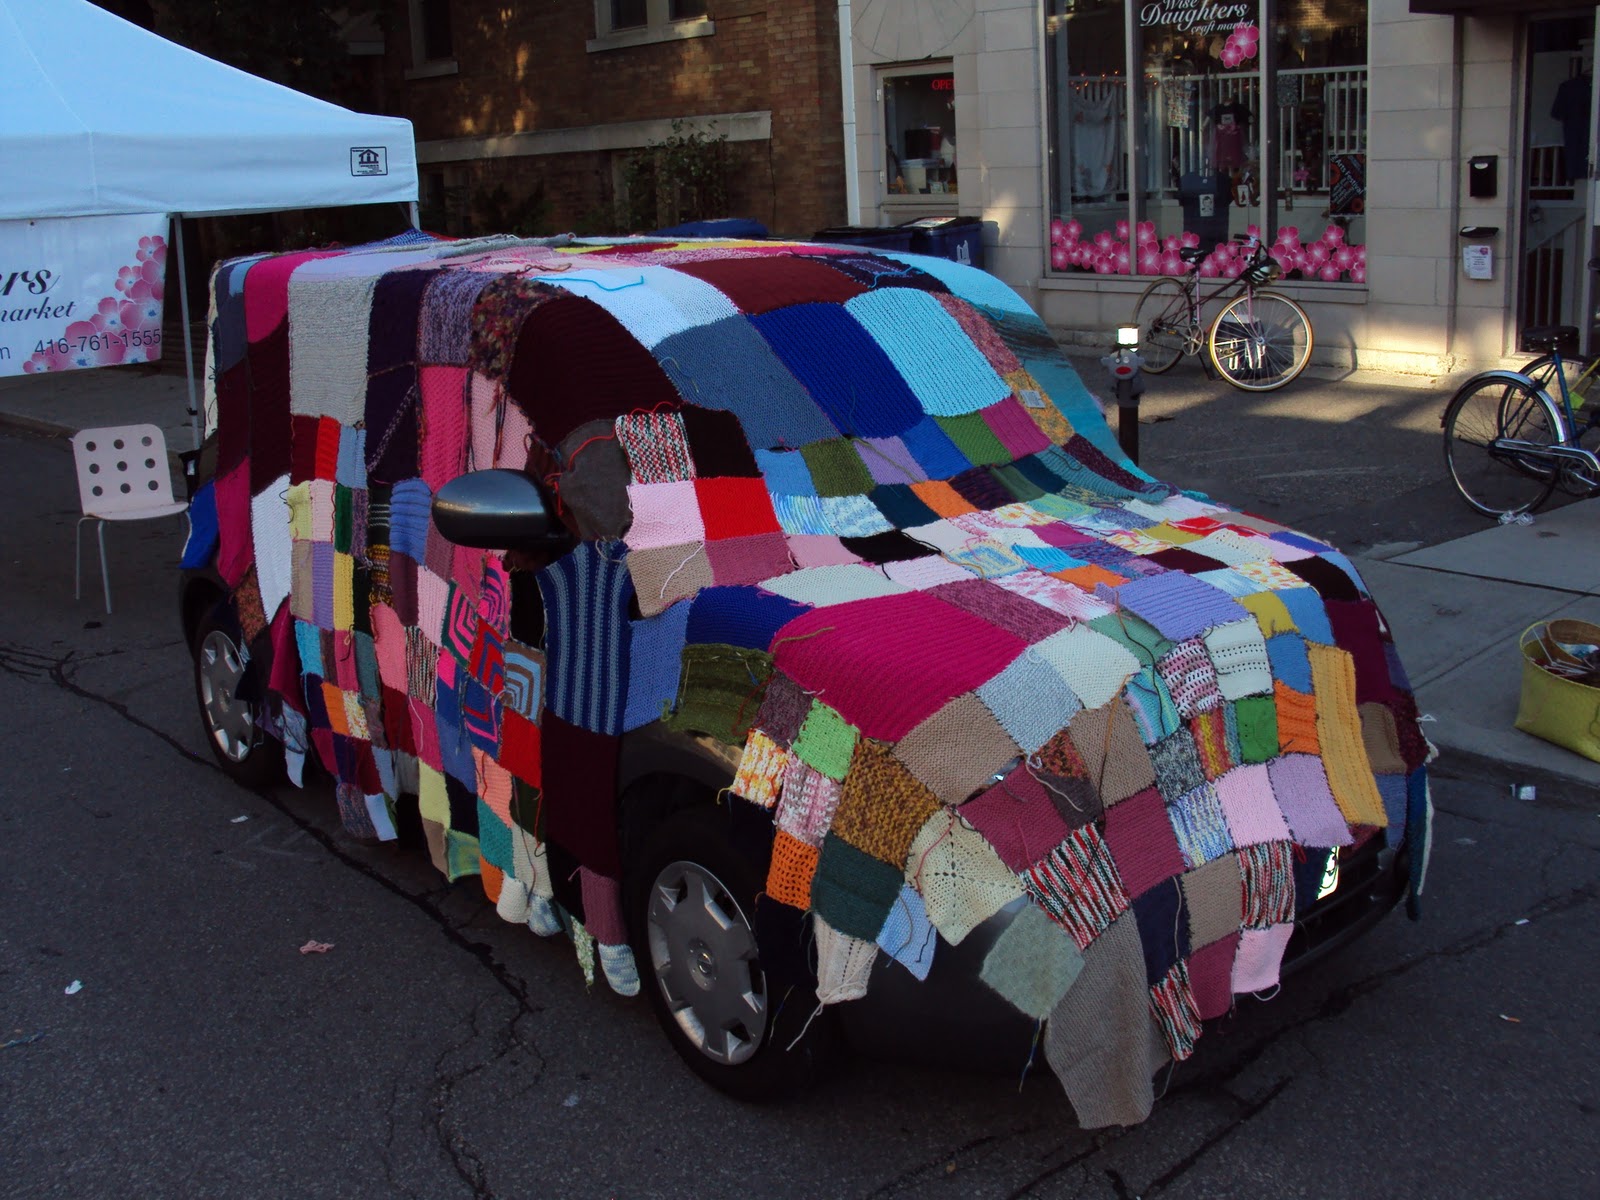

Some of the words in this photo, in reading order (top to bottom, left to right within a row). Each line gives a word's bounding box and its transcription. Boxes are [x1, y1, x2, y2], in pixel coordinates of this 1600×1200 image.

[1140, 3, 1251, 32] Daughters
[1162, 0, 1199, 11] Wise
[1190, 20, 1216, 36] craft
[1217, 17, 1254, 32] market
[0, 269, 61, 296] rs
[34, 328, 162, 356] 416-761-1555
